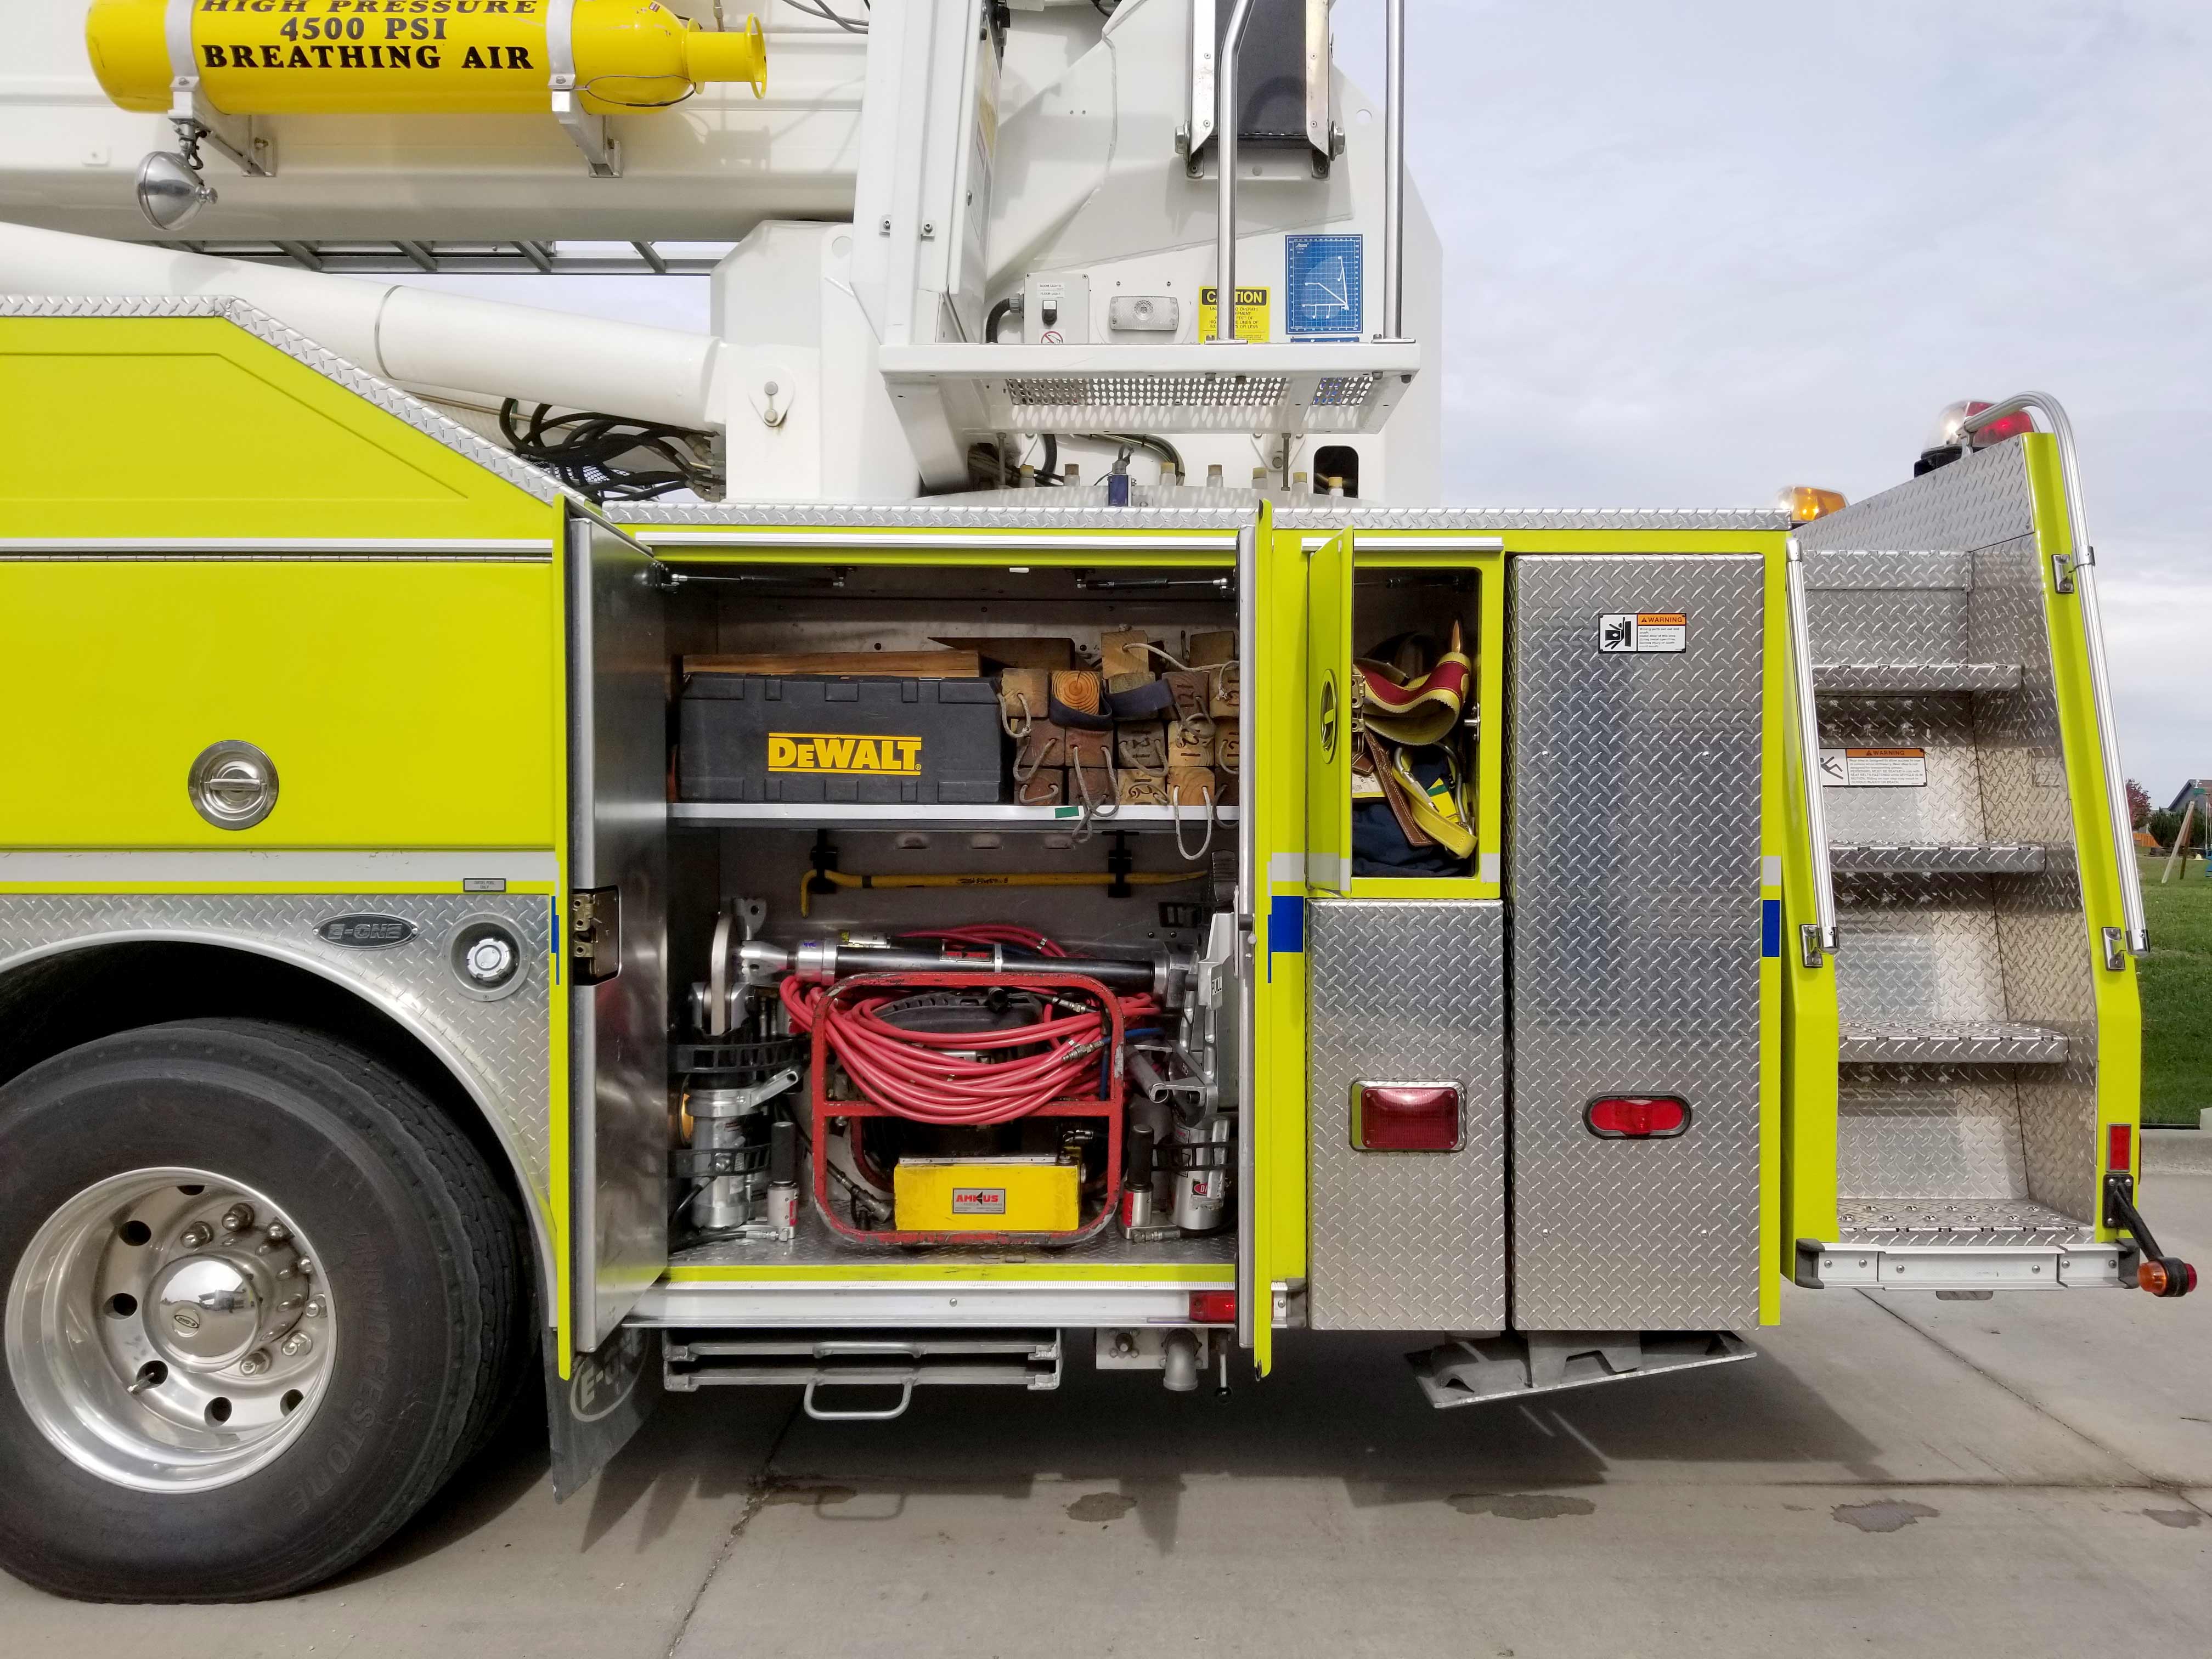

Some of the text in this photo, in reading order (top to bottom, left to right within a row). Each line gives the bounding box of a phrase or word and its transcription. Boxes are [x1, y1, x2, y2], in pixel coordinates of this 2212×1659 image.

[201, 0, 537, 13] HIGH PRESSURE
[280, 17, 447, 41] 4500 PSI
[201, 44, 534, 69] BREATHING AIR
[1206, 291, 1262, 303] CTION
[328, 924, 402, 939] E-ONE
[1212, 978, 1222, 993] PULL
[956, 1193, 999, 1203] AMKUS
